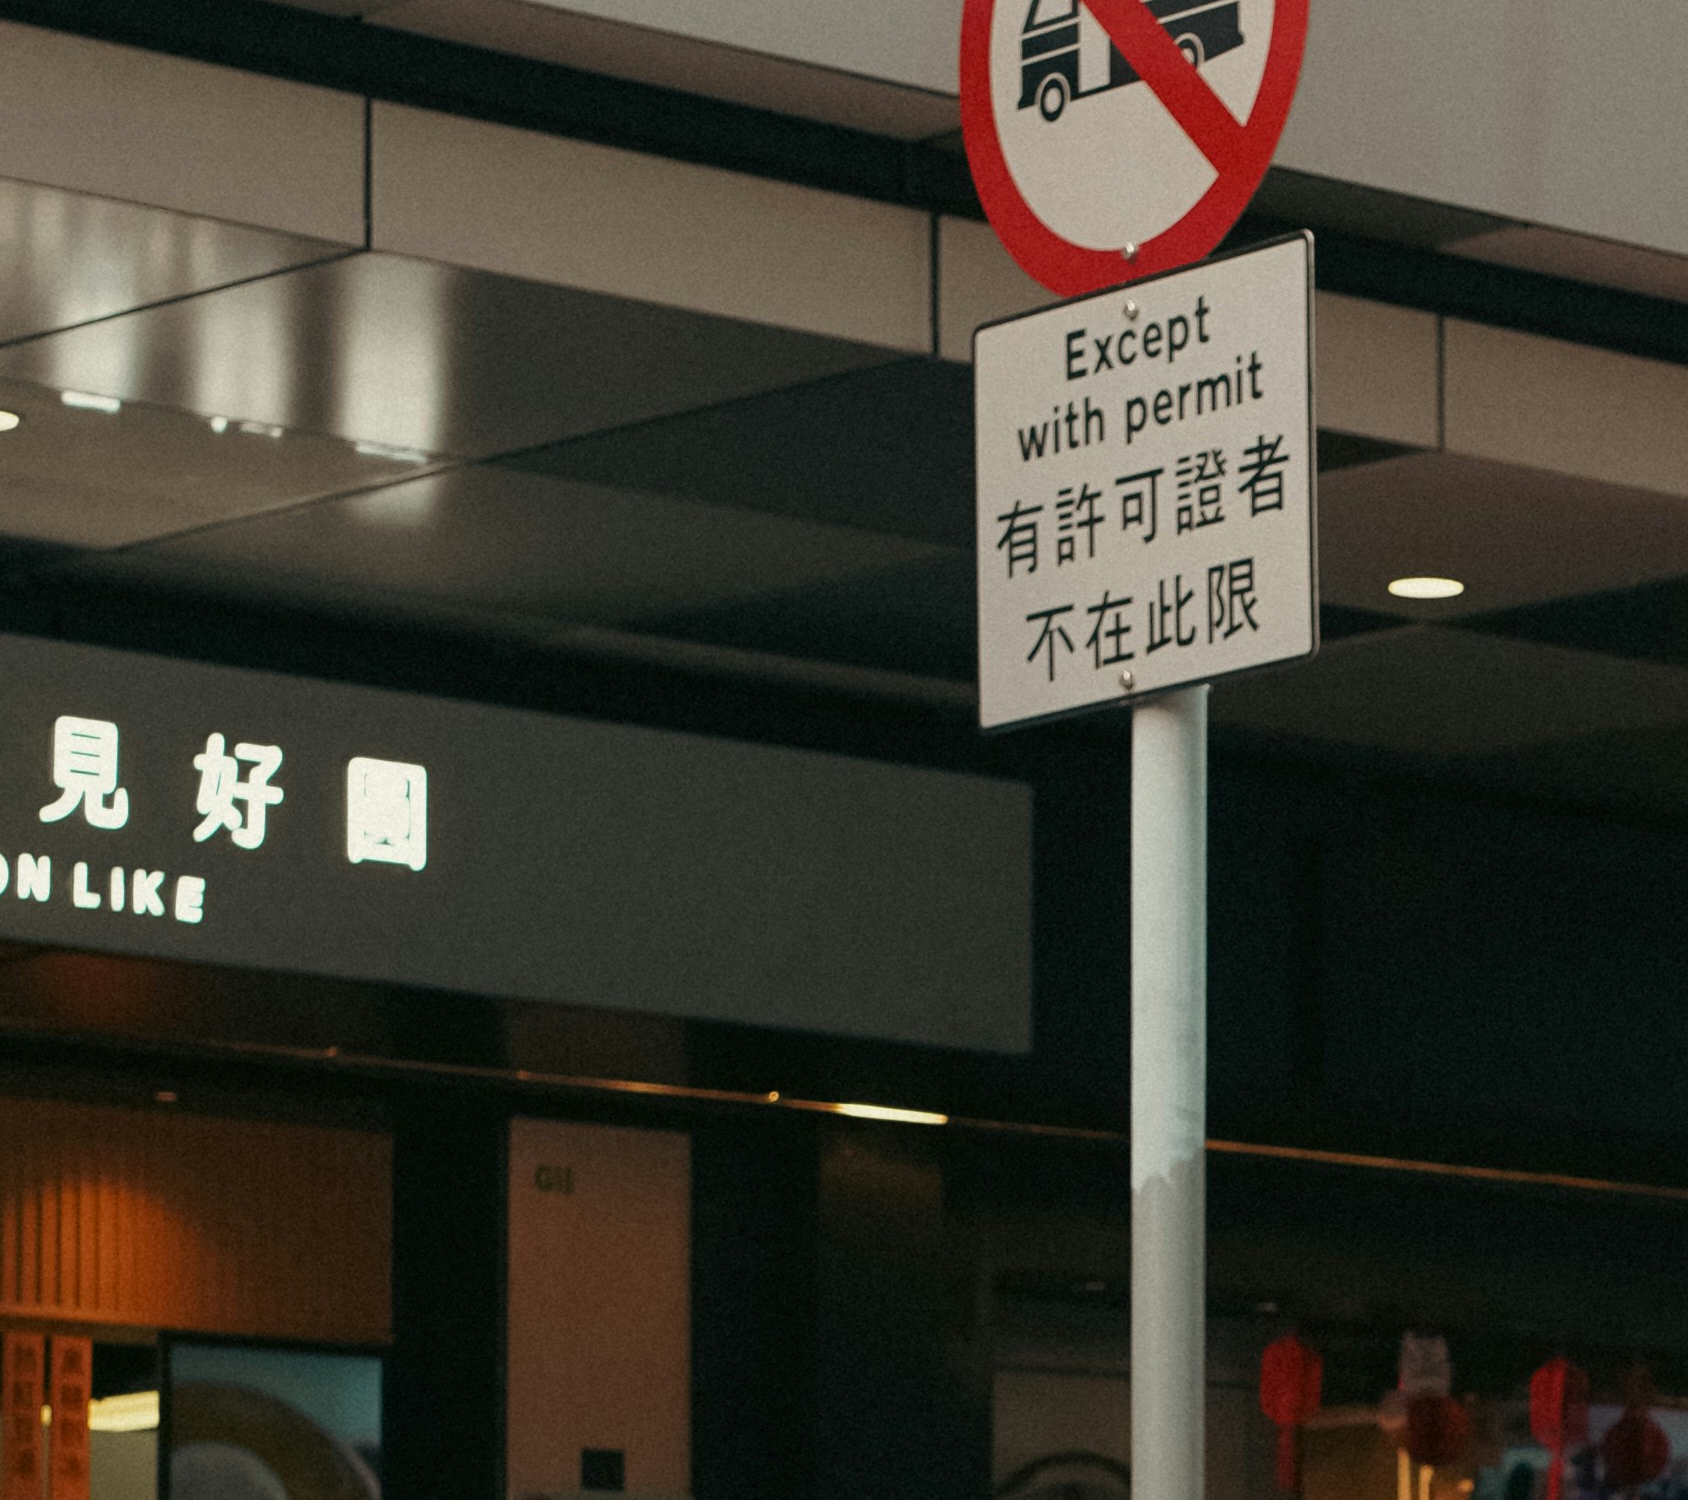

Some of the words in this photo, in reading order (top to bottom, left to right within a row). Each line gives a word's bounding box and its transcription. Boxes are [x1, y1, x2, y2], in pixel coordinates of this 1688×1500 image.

[1065, 295, 1210, 381] Except
[1018, 396, 1106, 462] with
[1126, 350, 1264, 444] permit
[997, 434, 1290, 579] 有許可證者
[1026, 556, 1259, 682] 不在此限
[73, 861, 206, 924] LIKE
